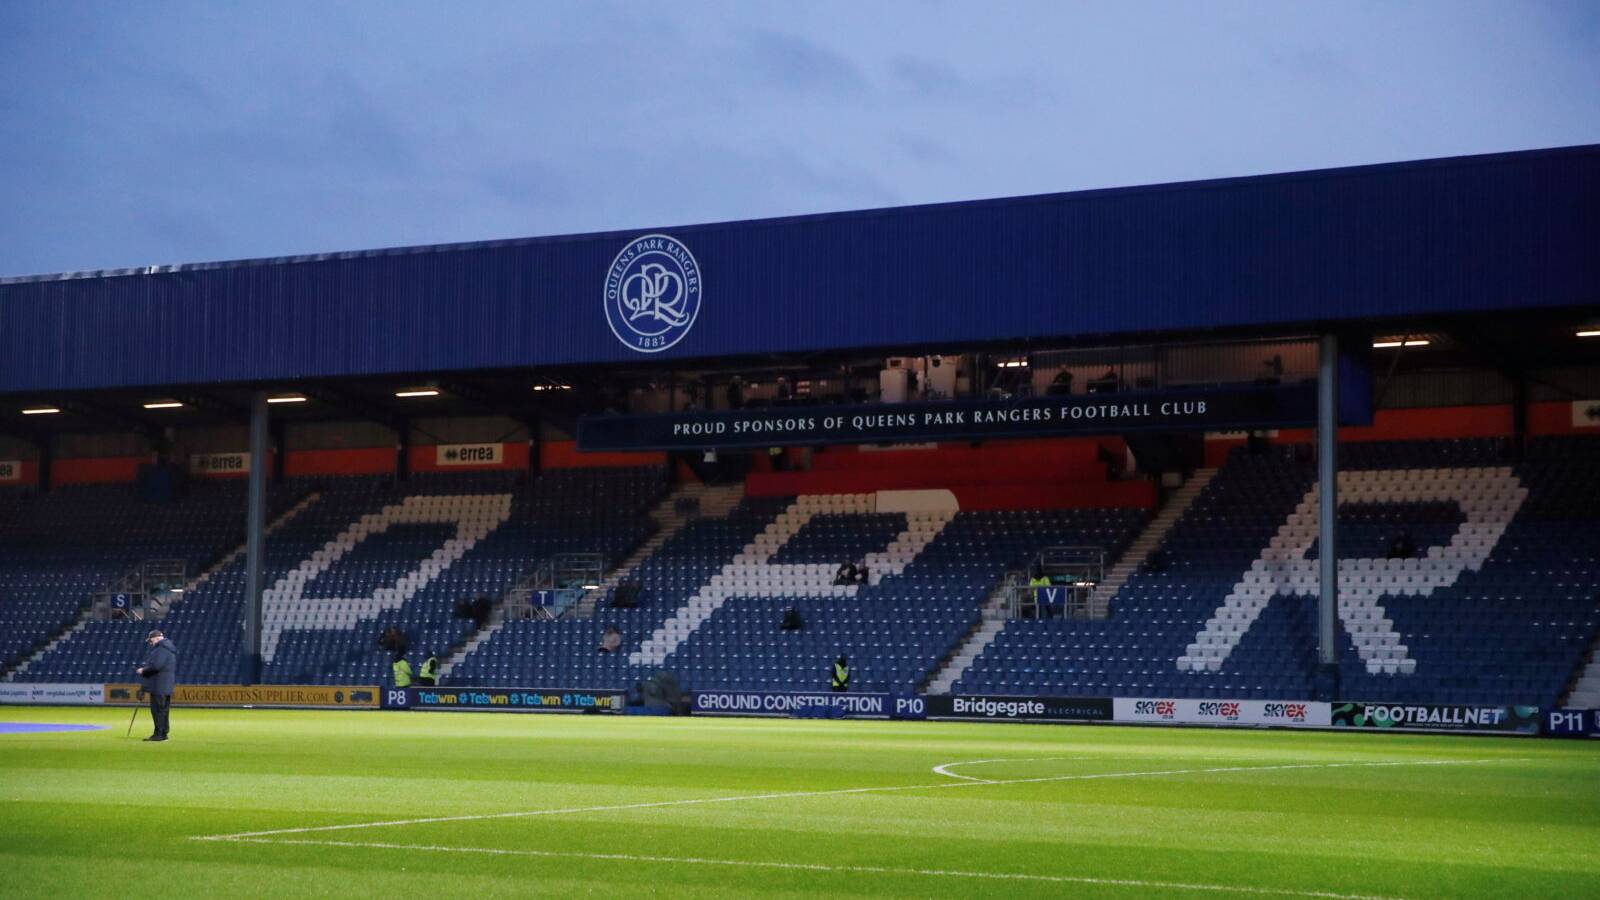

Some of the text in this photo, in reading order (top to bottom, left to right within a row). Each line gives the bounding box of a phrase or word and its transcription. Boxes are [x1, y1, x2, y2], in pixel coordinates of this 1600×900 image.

[608, 240, 698, 299] QUEENS PARK RANGERS
[638, 336, 666, 347] 1882
[673, 401, 1207, 436] PROUD SPONSORS OF QUEENS PARK RANGERS FOOTBALL CLUB
[460, 446, 494, 461] errea
[116, 594, 126, 608] S
[538, 590, 548, 605] T
[1045, 587, 1058, 604] V
[387, 690, 407, 705] P8
[697, 694, 883, 712] GROUND CONSTRUCTION
[896, 698, 924, 714] P10
[953, 697, 1104, 716] Bridgegate ELECTRICAL
[1363, 705, 1505, 724] FOOTBALLNET
[1550, 711, 1583, 731] P11
